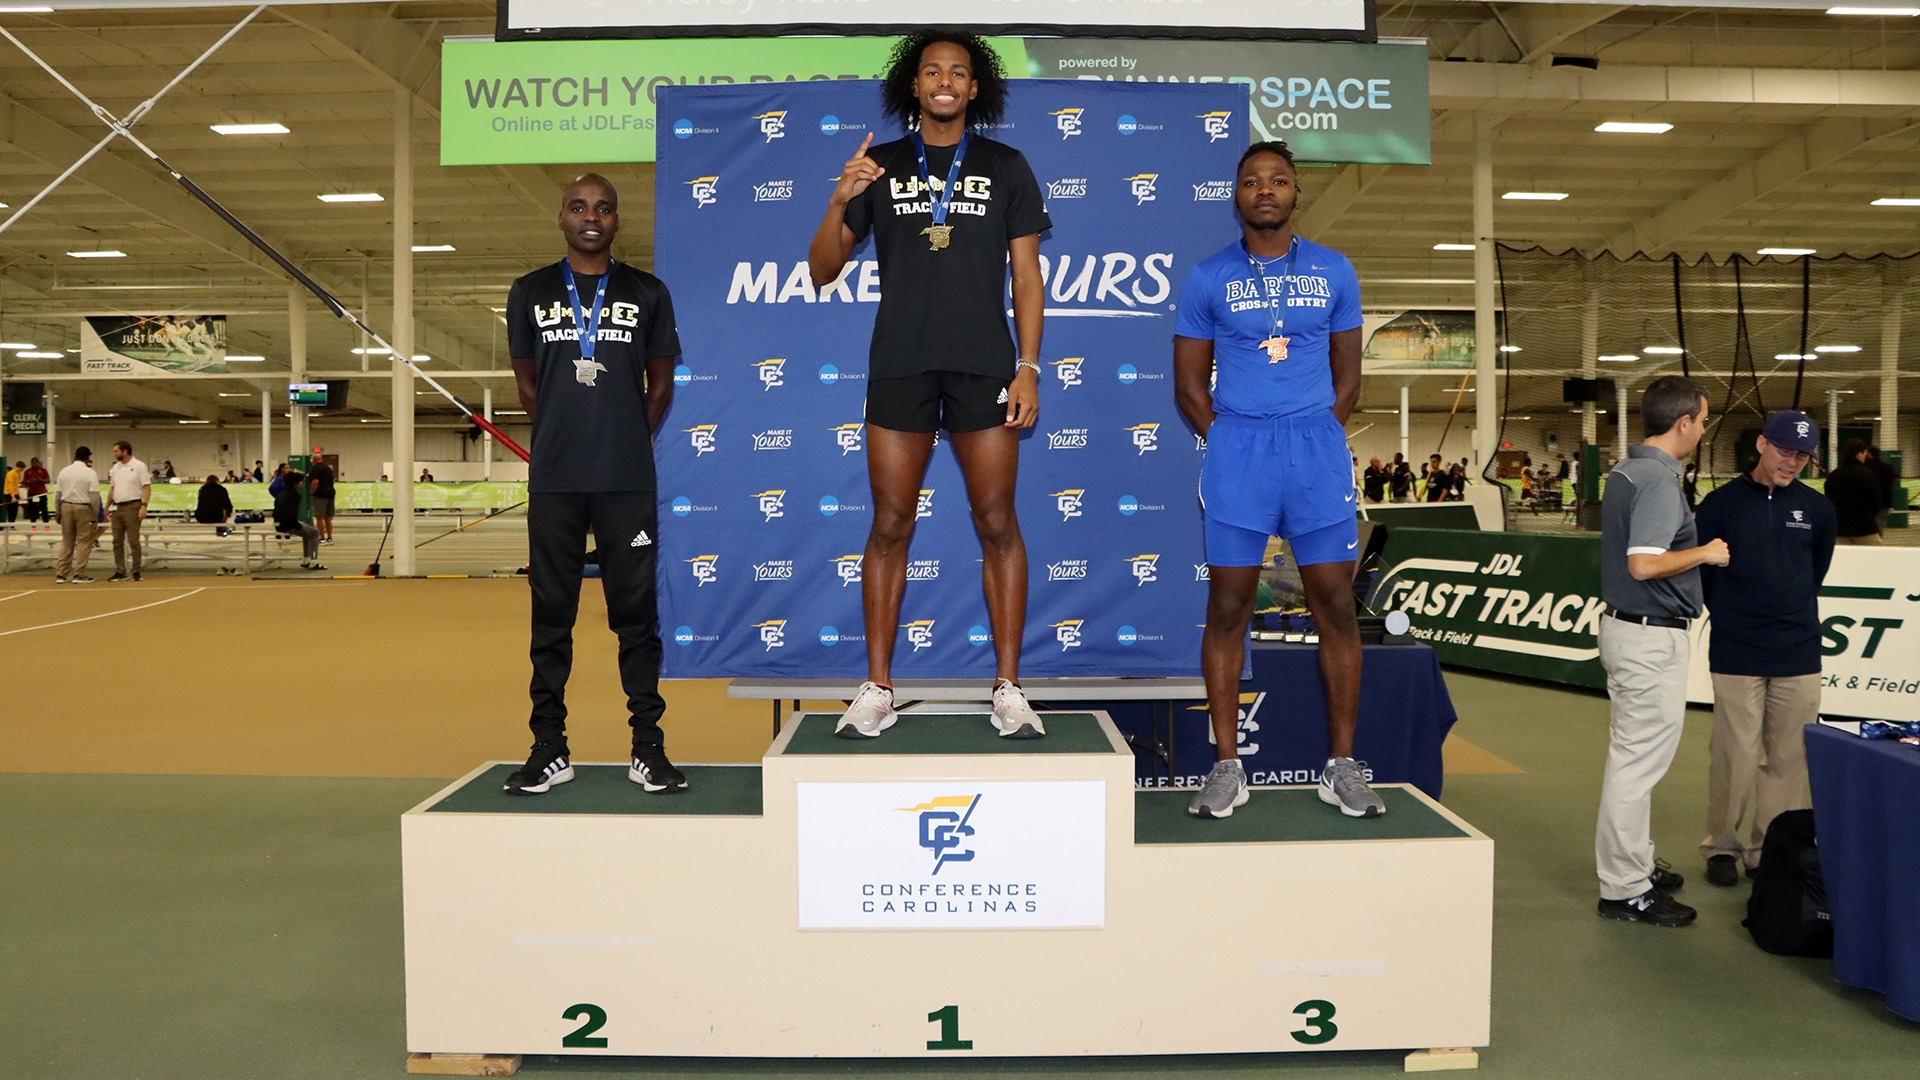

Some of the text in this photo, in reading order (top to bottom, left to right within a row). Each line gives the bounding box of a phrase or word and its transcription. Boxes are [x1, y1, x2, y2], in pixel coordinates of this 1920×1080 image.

[1059, 56, 1137, 70] powered by
[464, 77, 608, 109] WATCH
[491, 116, 554, 132] Online
[559, 117, 576, 132] at
[1118, 123, 1137, 131] NCAA
[1271, 111, 1338, 130] .com
[675, 127, 693, 135] NCAA
[753, 184, 793, 202] YOURS
[1047, 180, 1087, 199] YOURS
[1193, 183, 1233, 201] YOURS
[949, 202, 986, 217] FIELD
[727, 261, 881, 304] MAKE
[1272, 298, 1327, 308] CUNTRY
[122, 334, 146, 344] JUST
[597, 329, 632, 343] FIELD
[10, 422, 45, 430] CHECK-IN
[13, 413, 41, 422] CLERK/
[752, 432, 792, 450] YOURS
[1047, 431, 1087, 450] YOURS
[753, 563, 792, 581] YOURS
[1047, 562, 1087, 581] YOURS
[1481, 554, 1523, 576] JDL
[1383, 580, 1608, 636] FAST TRACK
[1434, 630, 1443, 641] &
[1443, 632, 1473, 645] Field
[1846, 676, 1859, 689] &
[1866, 677, 1920, 694] Field
[862, 883, 1037, 896] CONFERENCE
[862, 900, 1037, 913] CAROLINAS
[562, 1001, 1337, 1050] 2 1 3
